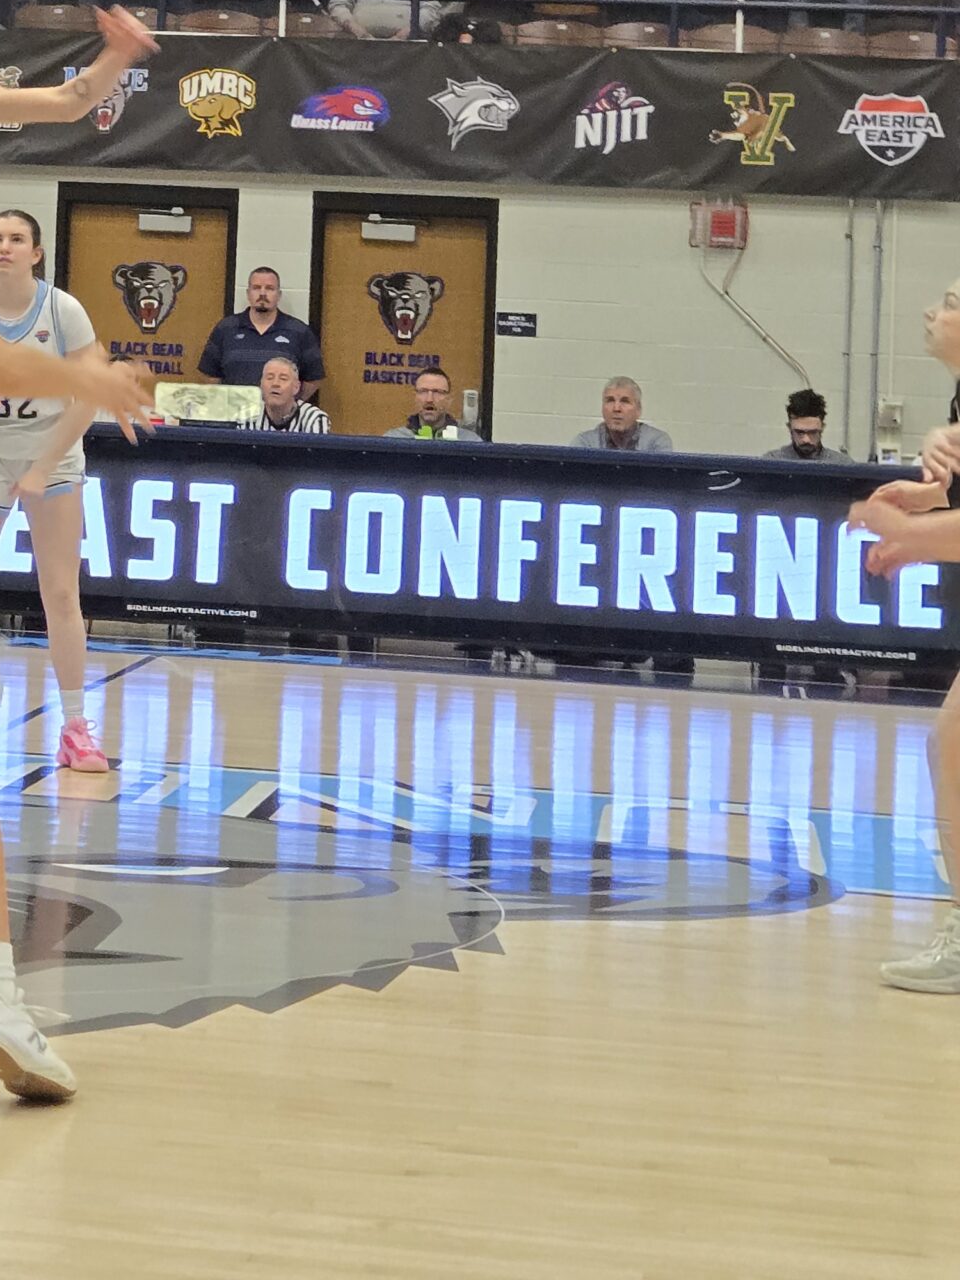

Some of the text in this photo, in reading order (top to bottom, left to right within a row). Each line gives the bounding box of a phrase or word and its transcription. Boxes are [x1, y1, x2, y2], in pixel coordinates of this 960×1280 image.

[182, 71, 253, 106] UMBC
[574, 105, 656, 155] NJIT
[844, 113, 939, 134] AMERICA
[865, 130, 917, 144] EAST
[110, 341, 183, 357] BLACK BEAR
[364, 352, 440, 369] BLACK BEAR
[286, 489, 943, 629] CONFERENCE
[126, 604, 249, 617] SIDELINEINTERACTIVE.COM
[775, 644, 908, 660] SIDELINEINTERACTIVE.COM
